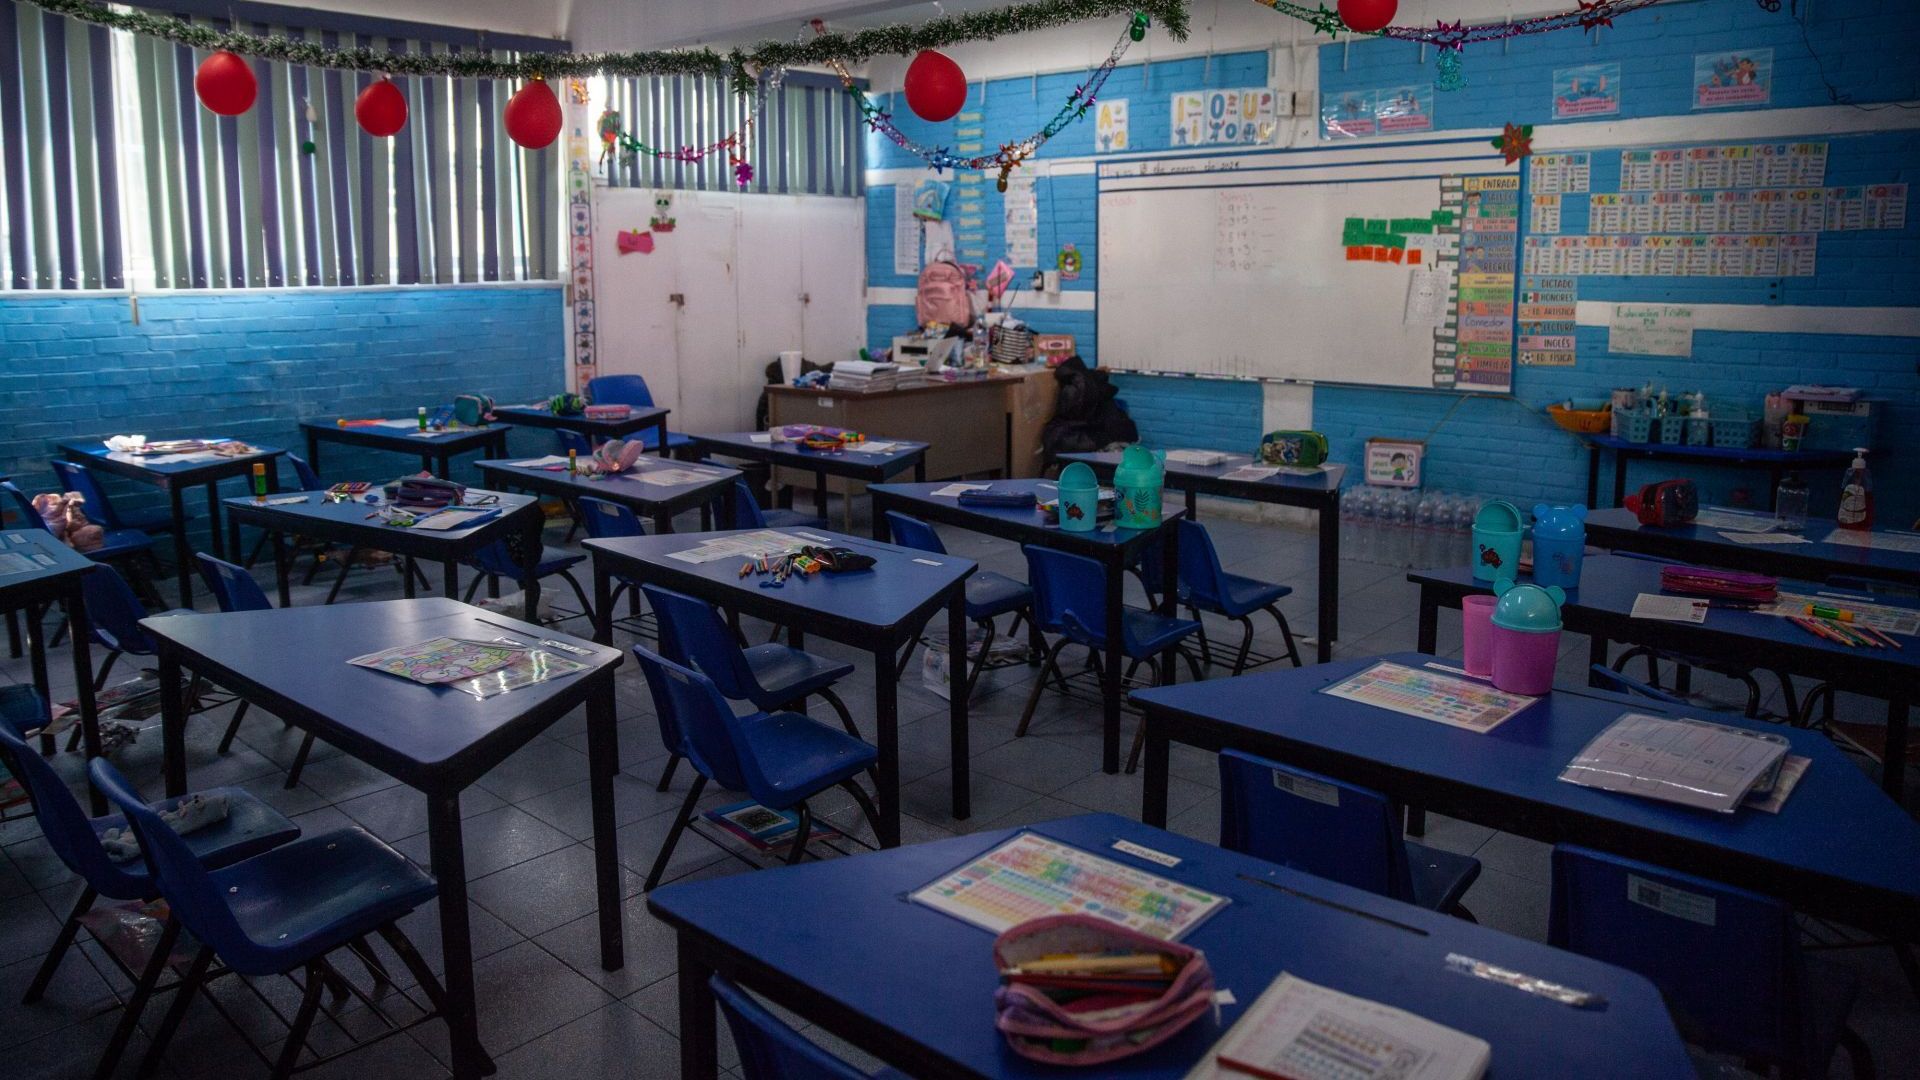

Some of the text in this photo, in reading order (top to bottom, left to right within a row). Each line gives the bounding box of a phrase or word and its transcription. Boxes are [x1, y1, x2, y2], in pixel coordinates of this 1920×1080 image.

[1177, 97, 1184, 122] I
[1210, 93, 1225, 119] O
[1243, 93, 1258, 120] U
[1099, 104, 1112, 129] A
[1225, 122, 1237, 139] o
[1482, 179, 1517, 189] ENTRADA
[1541, 279, 1573, 289] DICTADO
[1540, 294, 1573, 302] HONORES
[1543, 322, 1575, 332] LECTURA
[1544, 337, 1571, 348] INGLÉS
